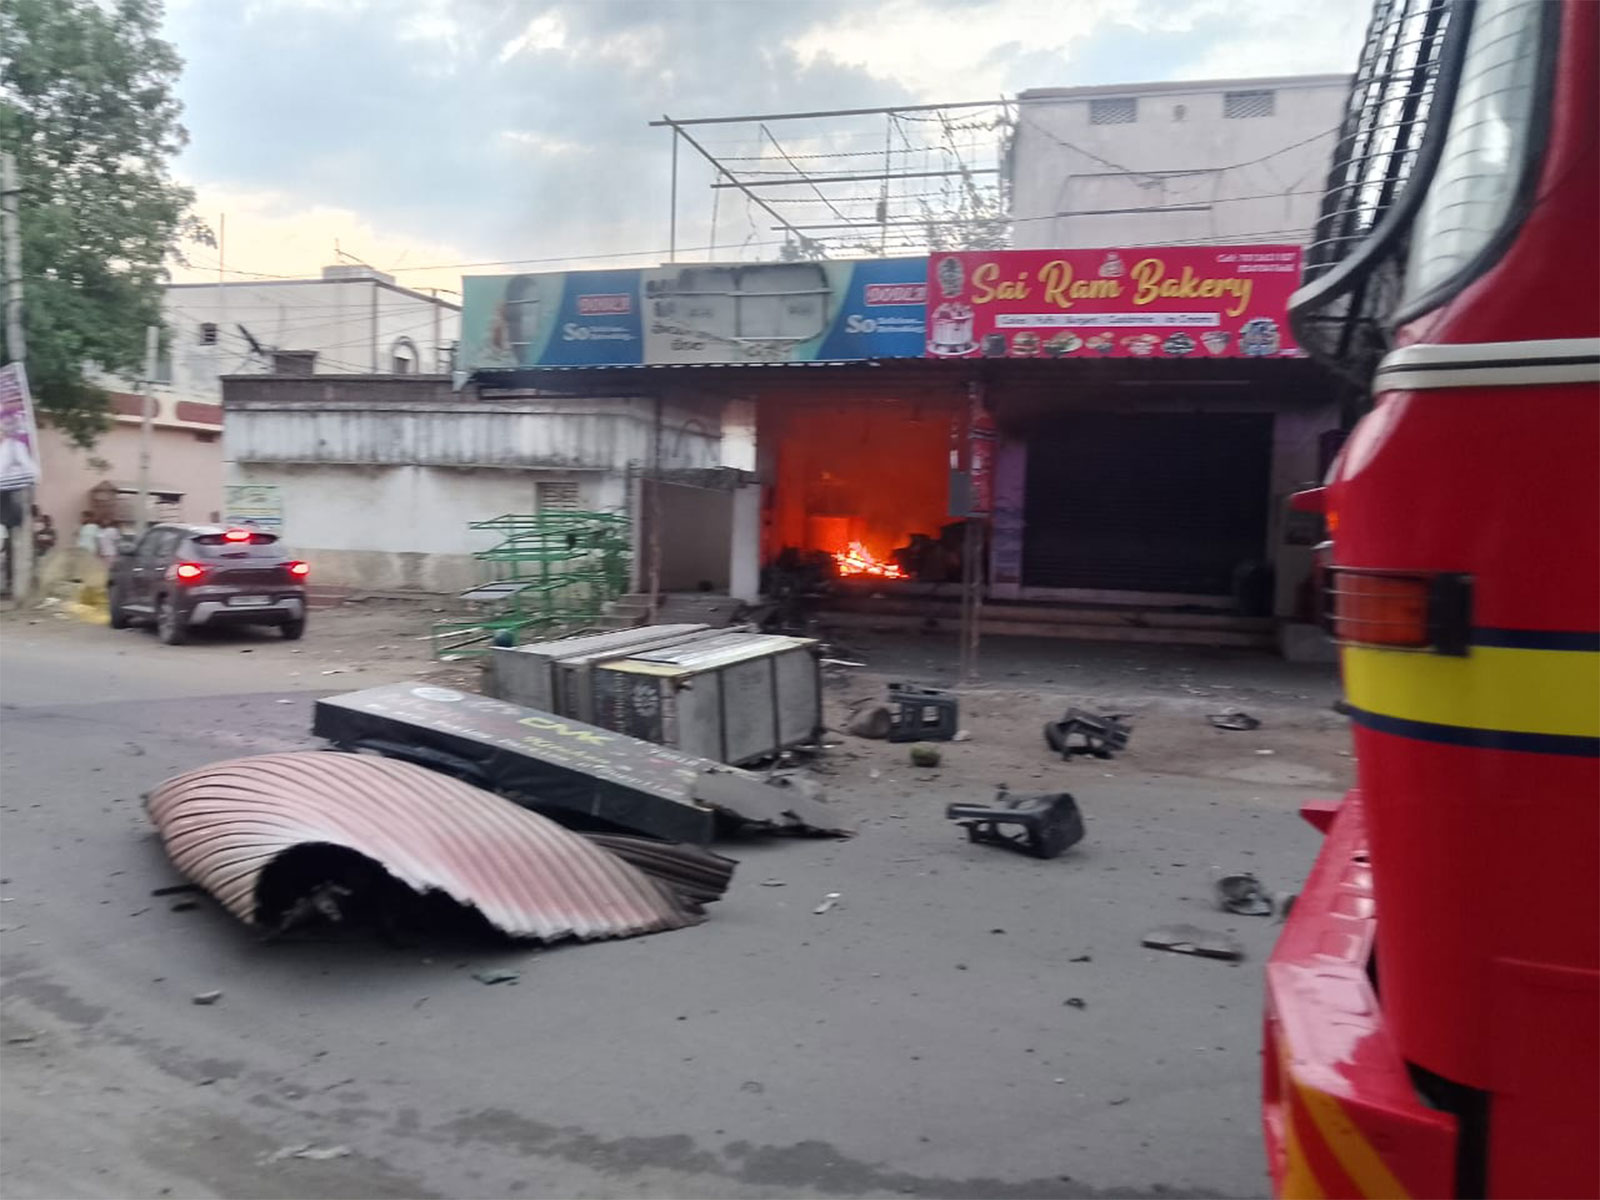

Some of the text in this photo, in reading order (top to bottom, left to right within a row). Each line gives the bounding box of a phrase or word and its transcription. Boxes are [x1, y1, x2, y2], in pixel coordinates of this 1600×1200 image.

[971, 258, 1252, 318] Sai Ram Bakery
[562, 322, 590, 341] So
[846, 314, 877, 334] So
